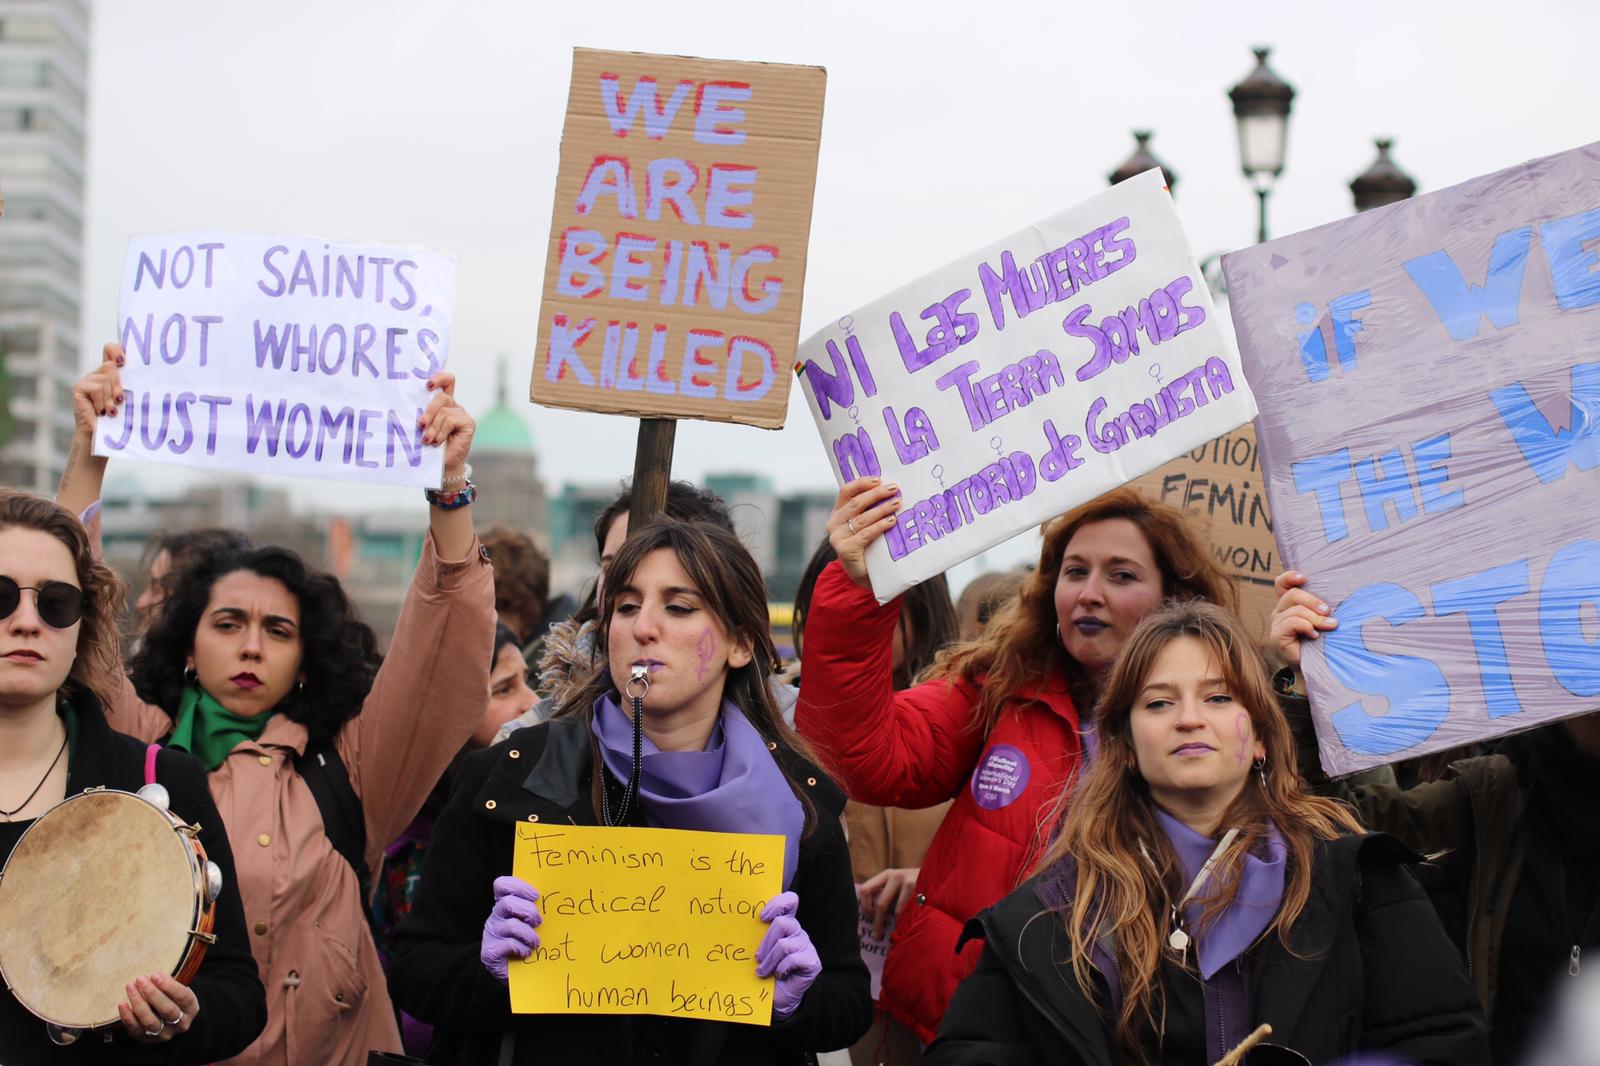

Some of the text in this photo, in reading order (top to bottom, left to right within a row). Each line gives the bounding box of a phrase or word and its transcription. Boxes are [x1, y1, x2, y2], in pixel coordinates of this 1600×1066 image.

[600, 71, 752, 145] WE
[574, 154, 758, 230] ARE
[133, 242, 225, 292] NOT
[556, 226, 784, 315] BEING
[978, 216, 1137, 331] MUJERES
[1402, 208, 1600, 342] WE
[121, 312, 439, 380] NOT WHORES
[545, 313, 780, 401] KILLED
[936, 349, 1065, 432] TIERRA
[103, 389, 425, 469] JUST WOMEN
[1040, 420, 1085, 483] de
[1291, 433, 1466, 545] THE
[690, 848, 712, 871] is
[725, 850, 766, 876] the
[541, 885, 666, 916] radical
[601, 942, 690, 964] women
[706, 943, 750, 962] are
[566, 973, 649, 1009] human
